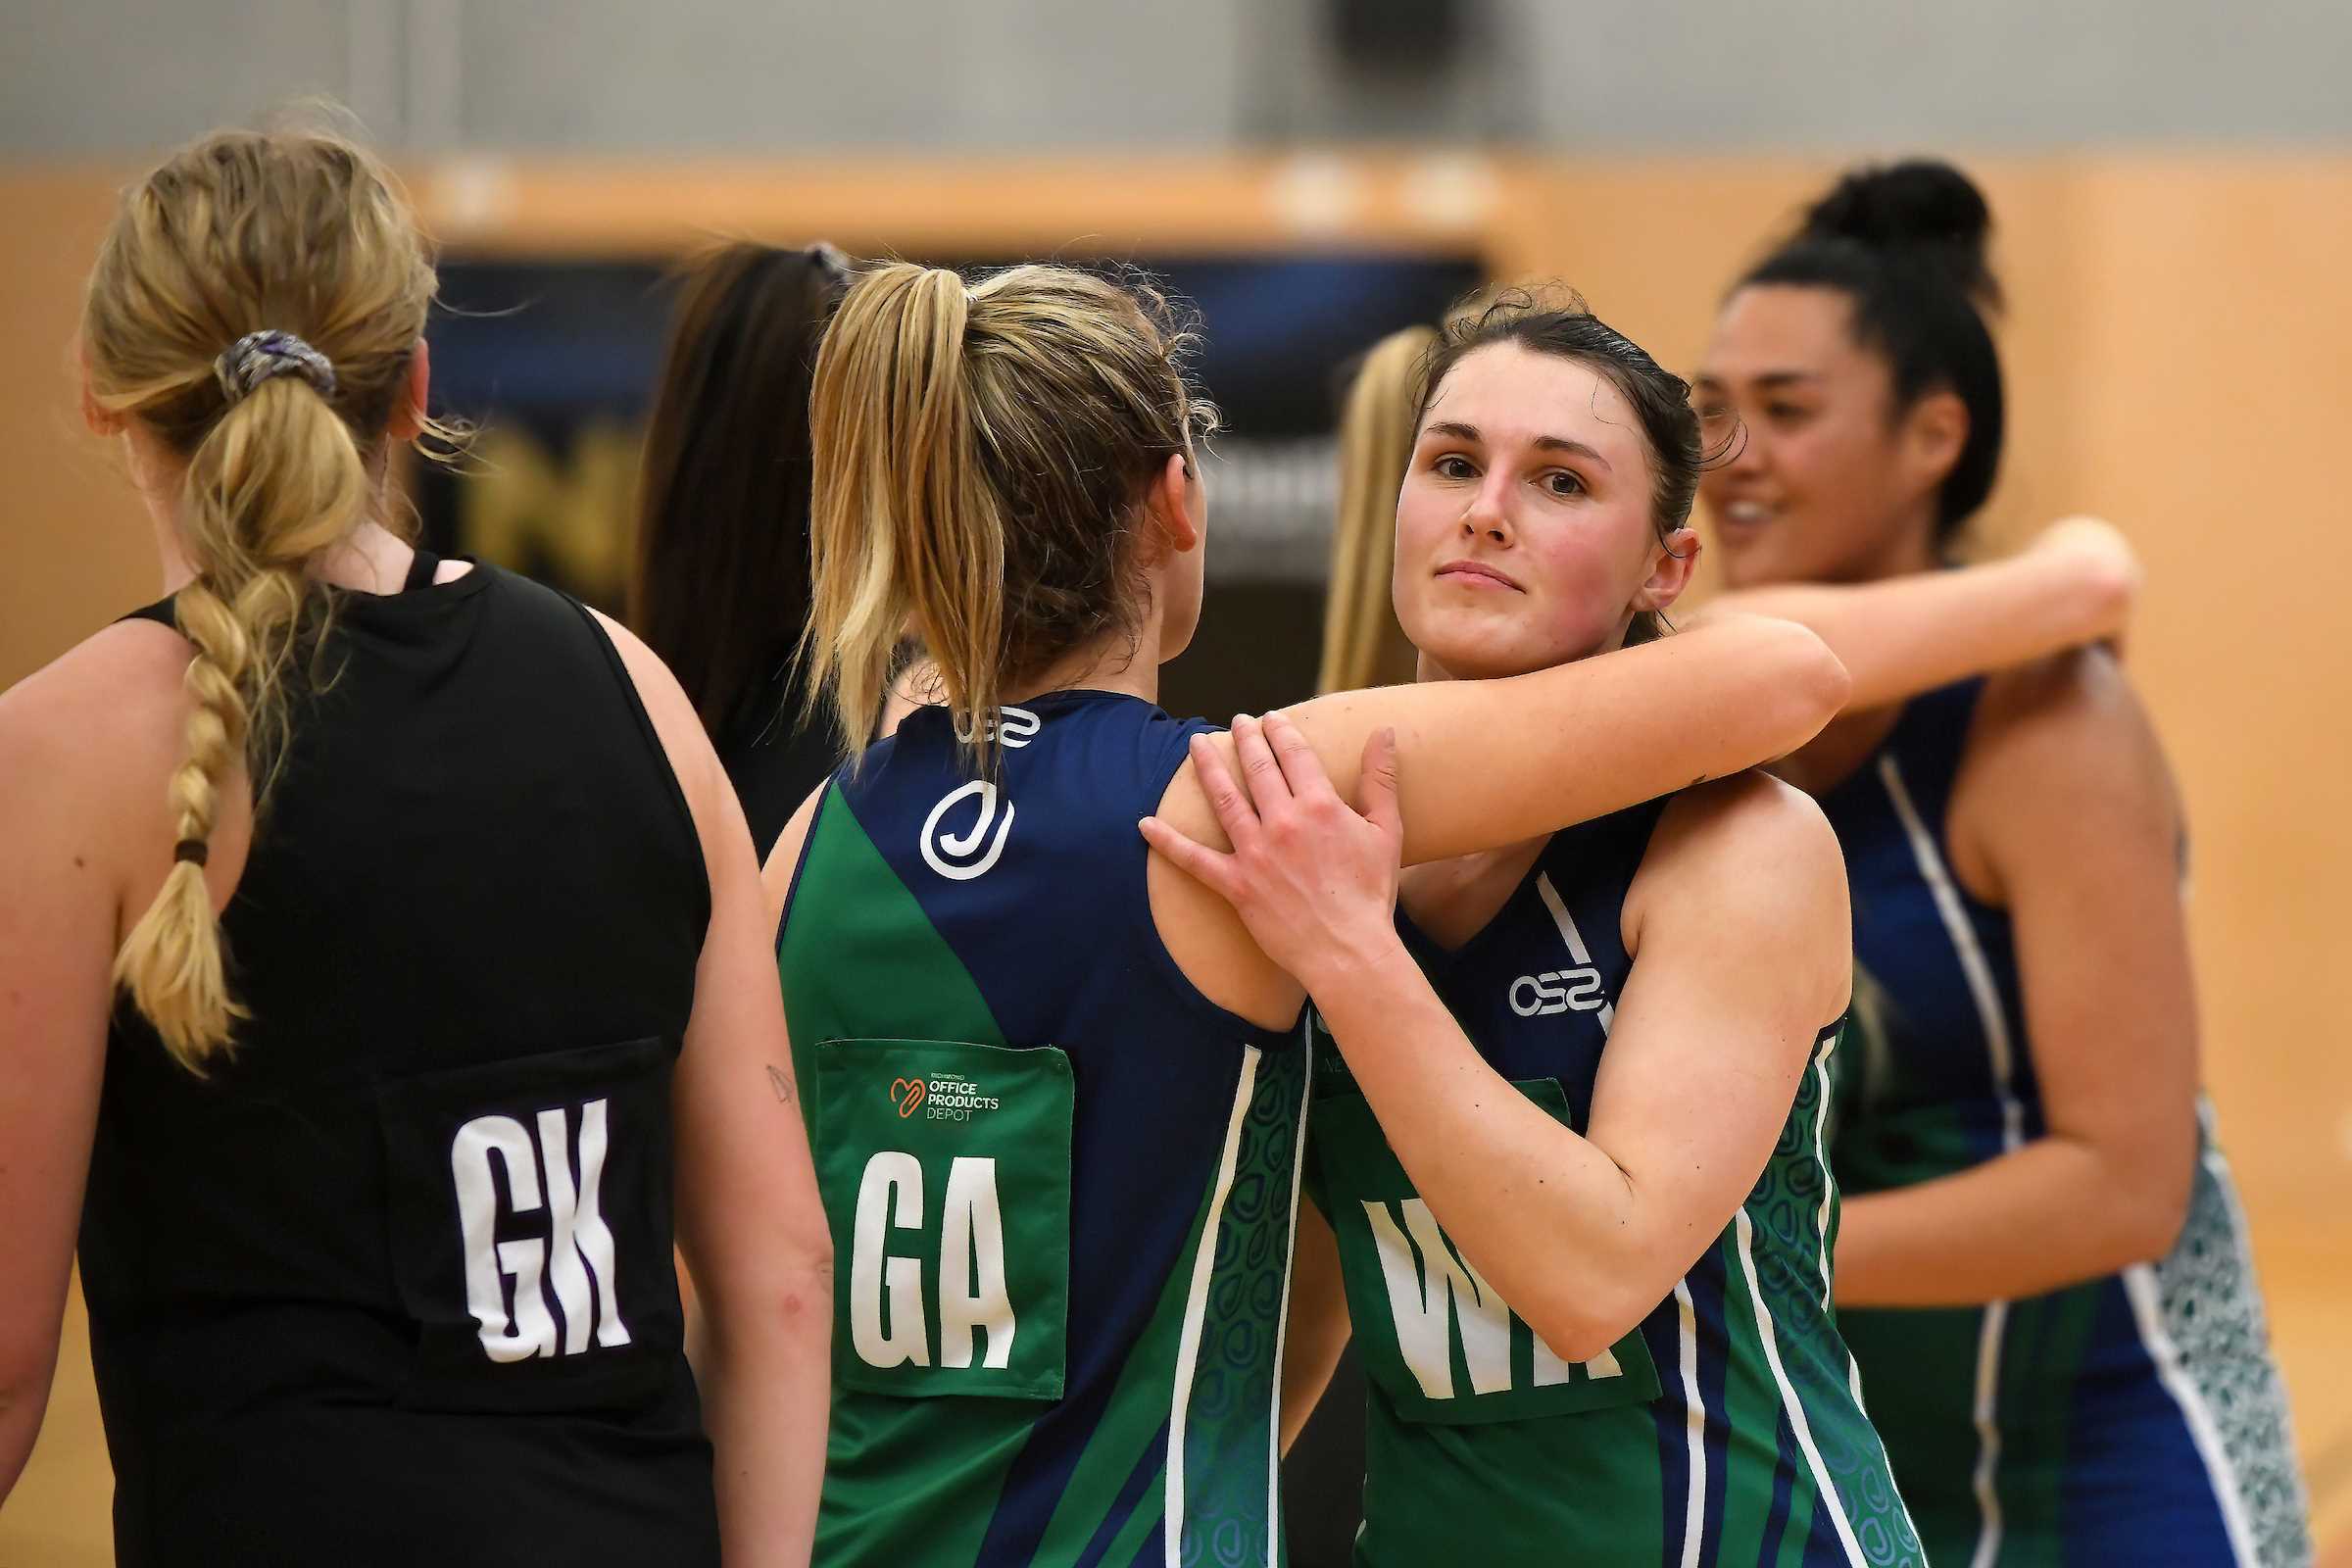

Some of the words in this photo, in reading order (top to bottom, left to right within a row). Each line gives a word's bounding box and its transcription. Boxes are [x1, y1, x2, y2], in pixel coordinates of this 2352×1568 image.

[926, 1107, 973, 1122] DEPOT
[927, 1094, 1000, 1110] PRODUCTS
[929, 1080, 978, 1095] OFFICE
[452, 1098, 632, 1363] GK
[851, 1151, 1016, 1369] GA
[1360, 1198, 1623, 1399] W
